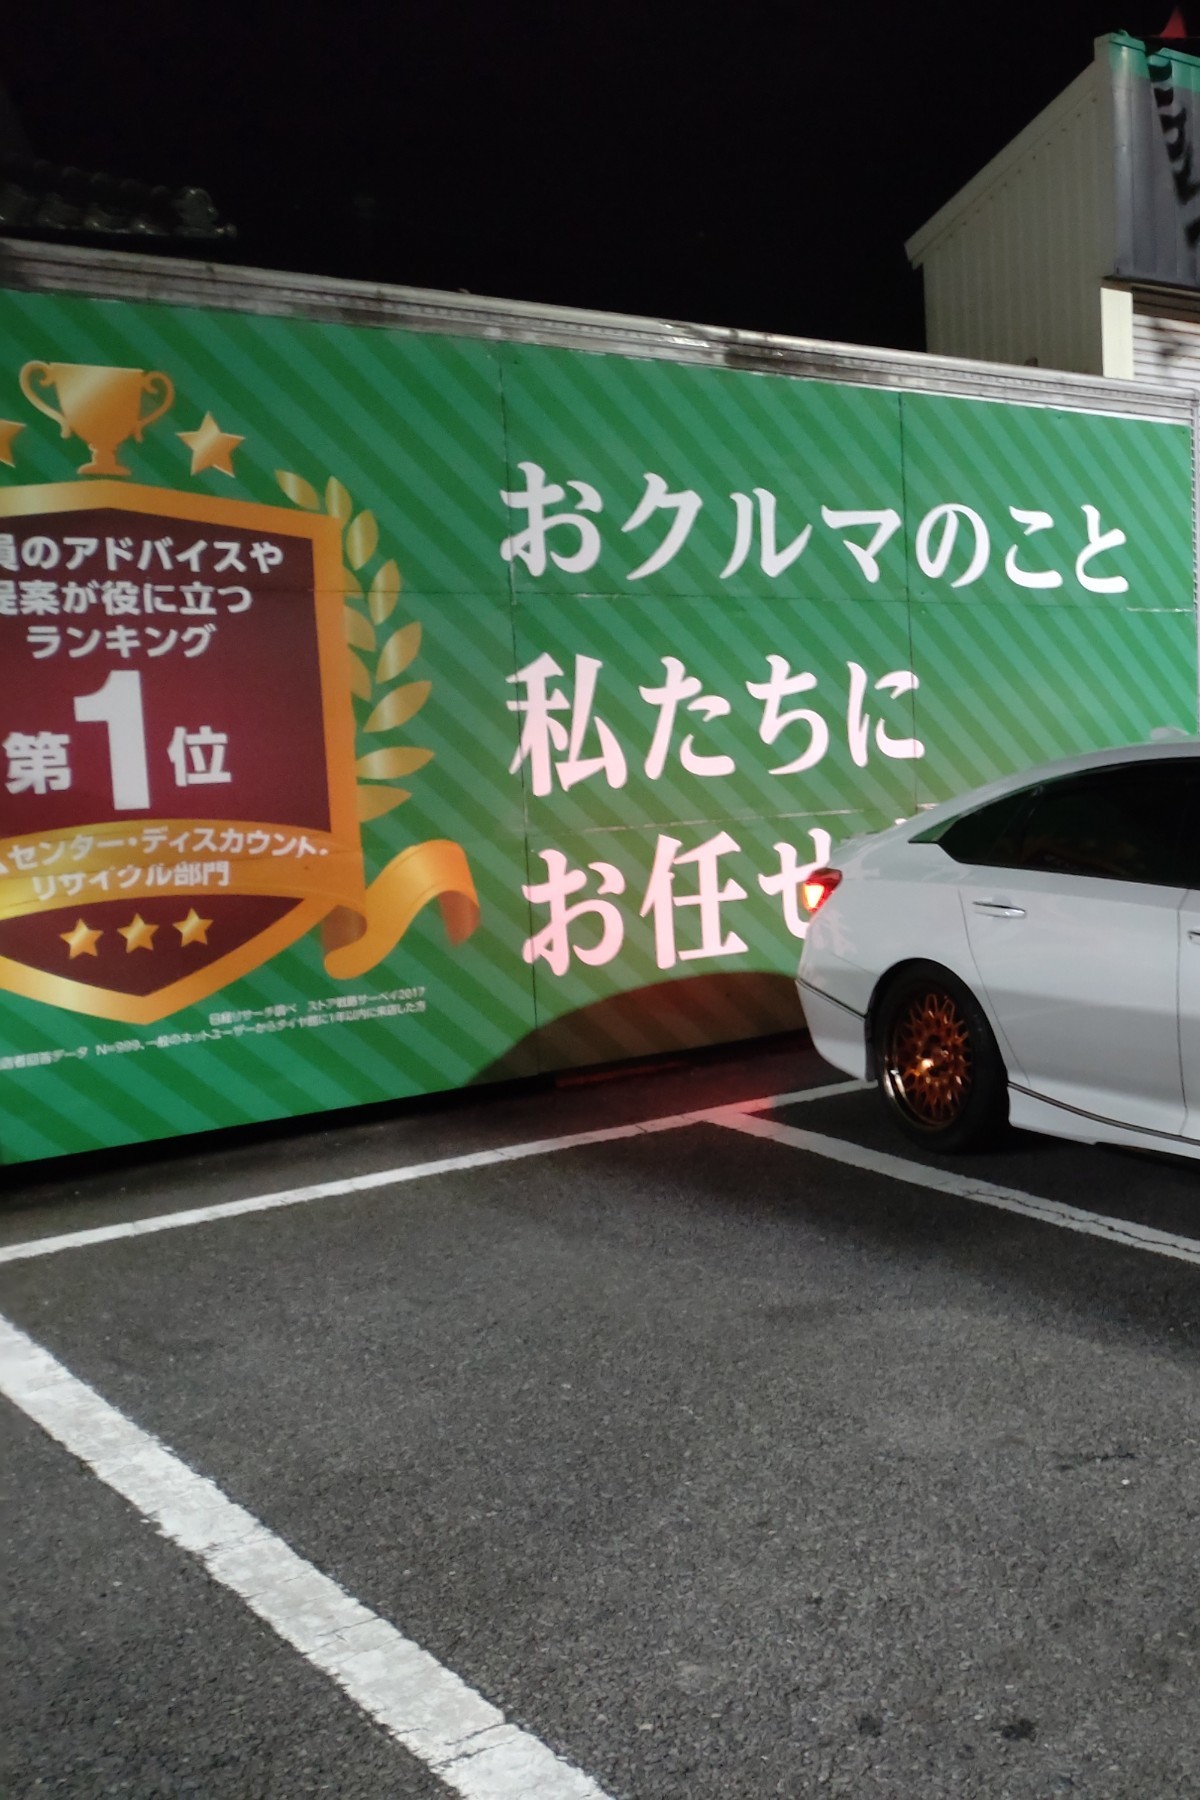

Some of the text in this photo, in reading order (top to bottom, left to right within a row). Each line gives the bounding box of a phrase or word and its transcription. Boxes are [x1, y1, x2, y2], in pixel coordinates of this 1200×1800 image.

[499, 461, 1130, 594] おクルマのこと
[26, 623, 217, 659] ランキング
[505, 651, 925, 798] 私たちに
[32, 859, 230, 901] リサイクル部門
